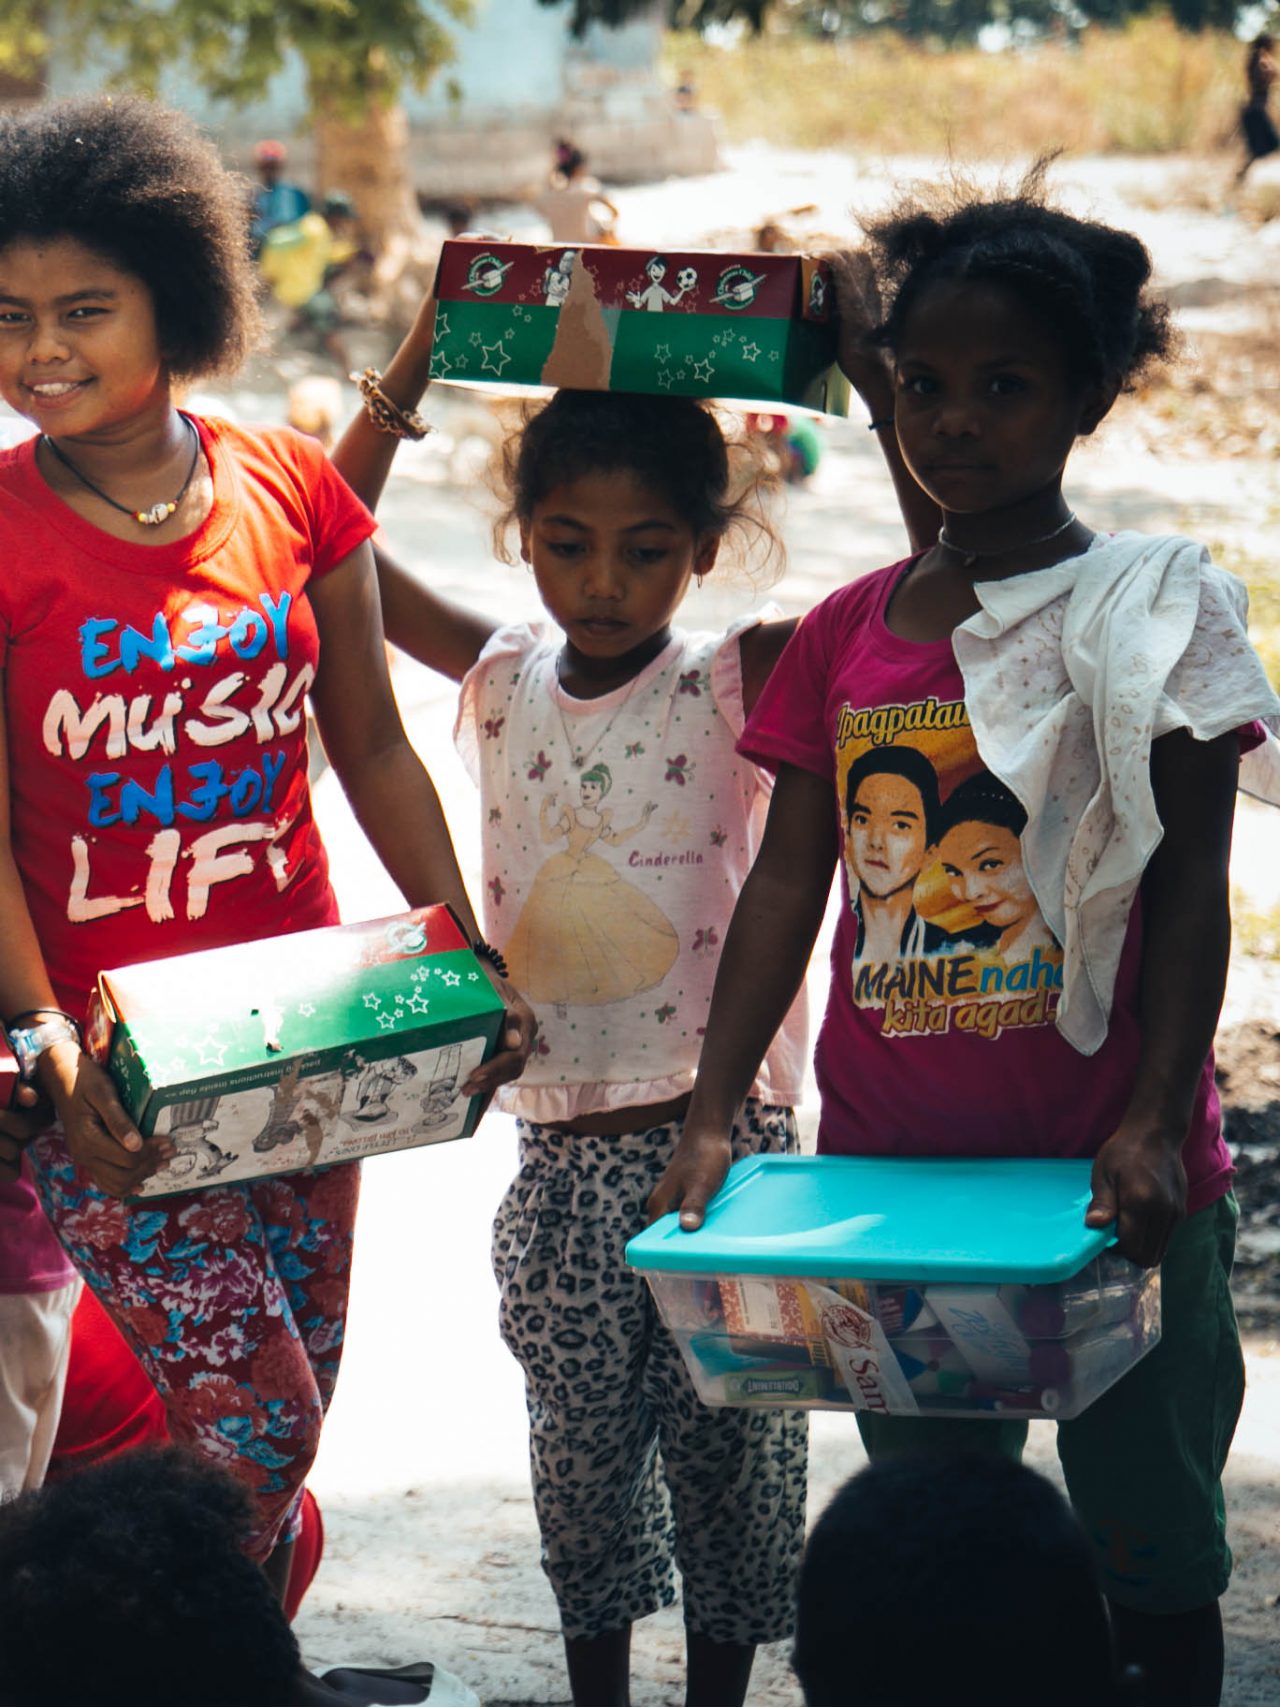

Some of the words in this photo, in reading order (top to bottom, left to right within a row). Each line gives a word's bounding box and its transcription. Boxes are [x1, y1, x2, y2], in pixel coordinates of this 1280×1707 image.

[78, 591, 292, 679] ENJOY
[85, 750, 287, 828] ENJOY
[628, 850, 704, 868] Cinderella
[854, 955, 977, 1000] MAINE
[881, 998, 948, 1036] kita
